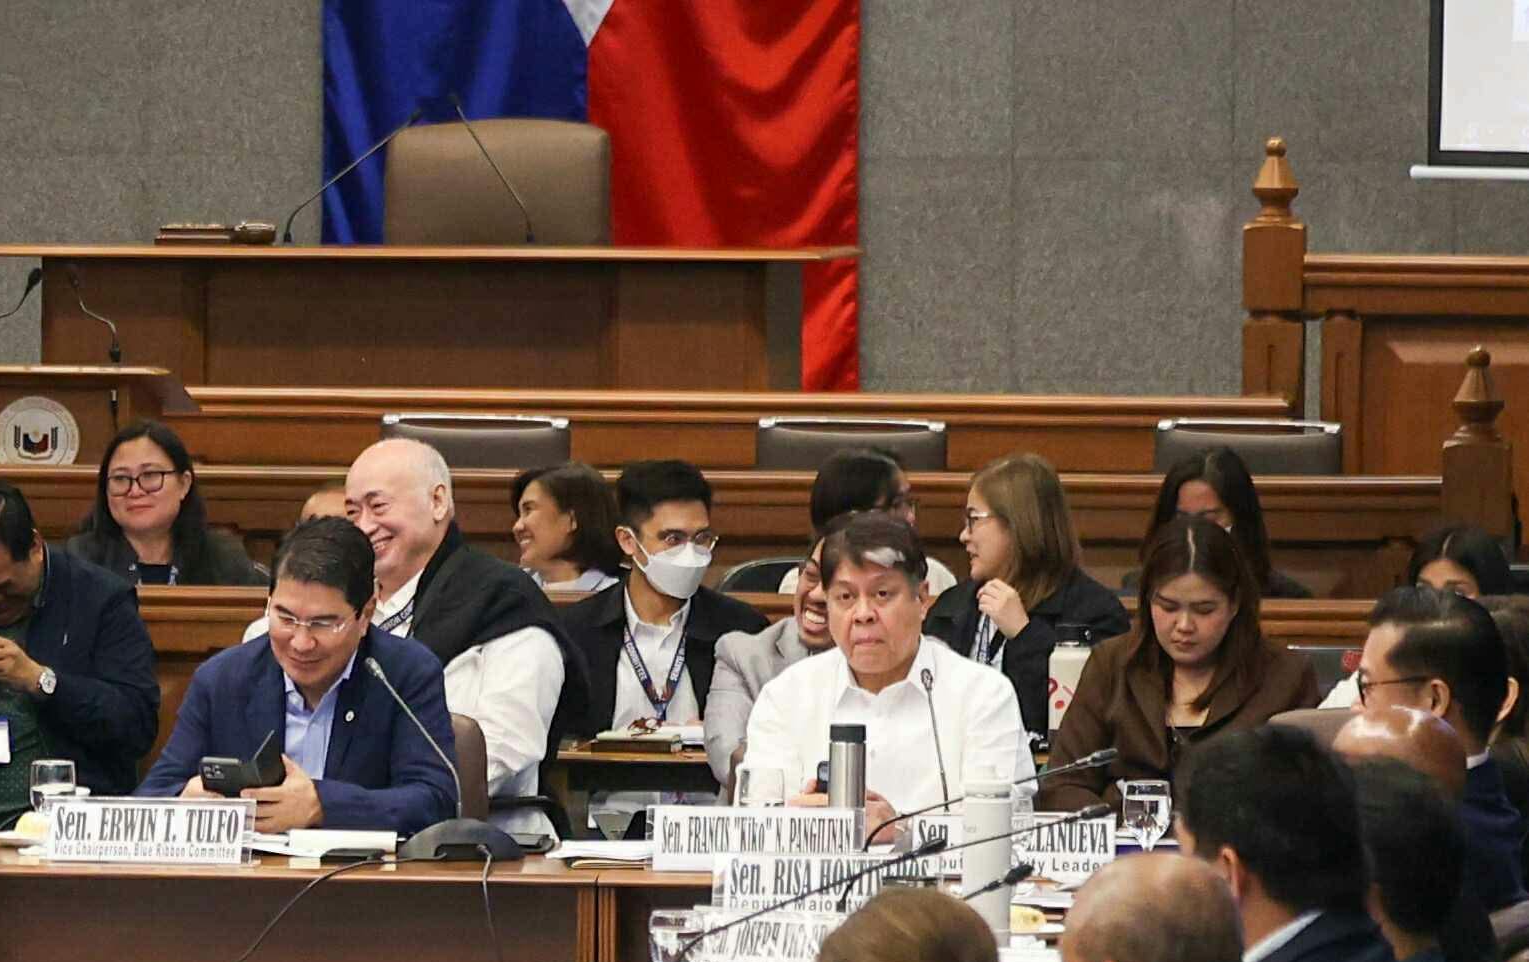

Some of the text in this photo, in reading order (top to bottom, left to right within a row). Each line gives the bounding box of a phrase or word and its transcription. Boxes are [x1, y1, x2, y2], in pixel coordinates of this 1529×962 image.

[55, 806, 239, 844] Sen. ERWIN T. TULFO
[662, 816, 683, 853] Sen.
[688, 816, 729, 854] FRANCIS
[734, 817, 771, 853] "Kiko"
[790, 817, 853, 854] PANGILINAN
[54, 842, 72, 855] Vice
[75, 843, 132, 859] Chairperson,
[156, 843, 186, 857] Ribbon
[188, 844, 236, 859] Committee
[730, 858, 765, 896] Sen.
[773, 858, 813, 896] RISA
